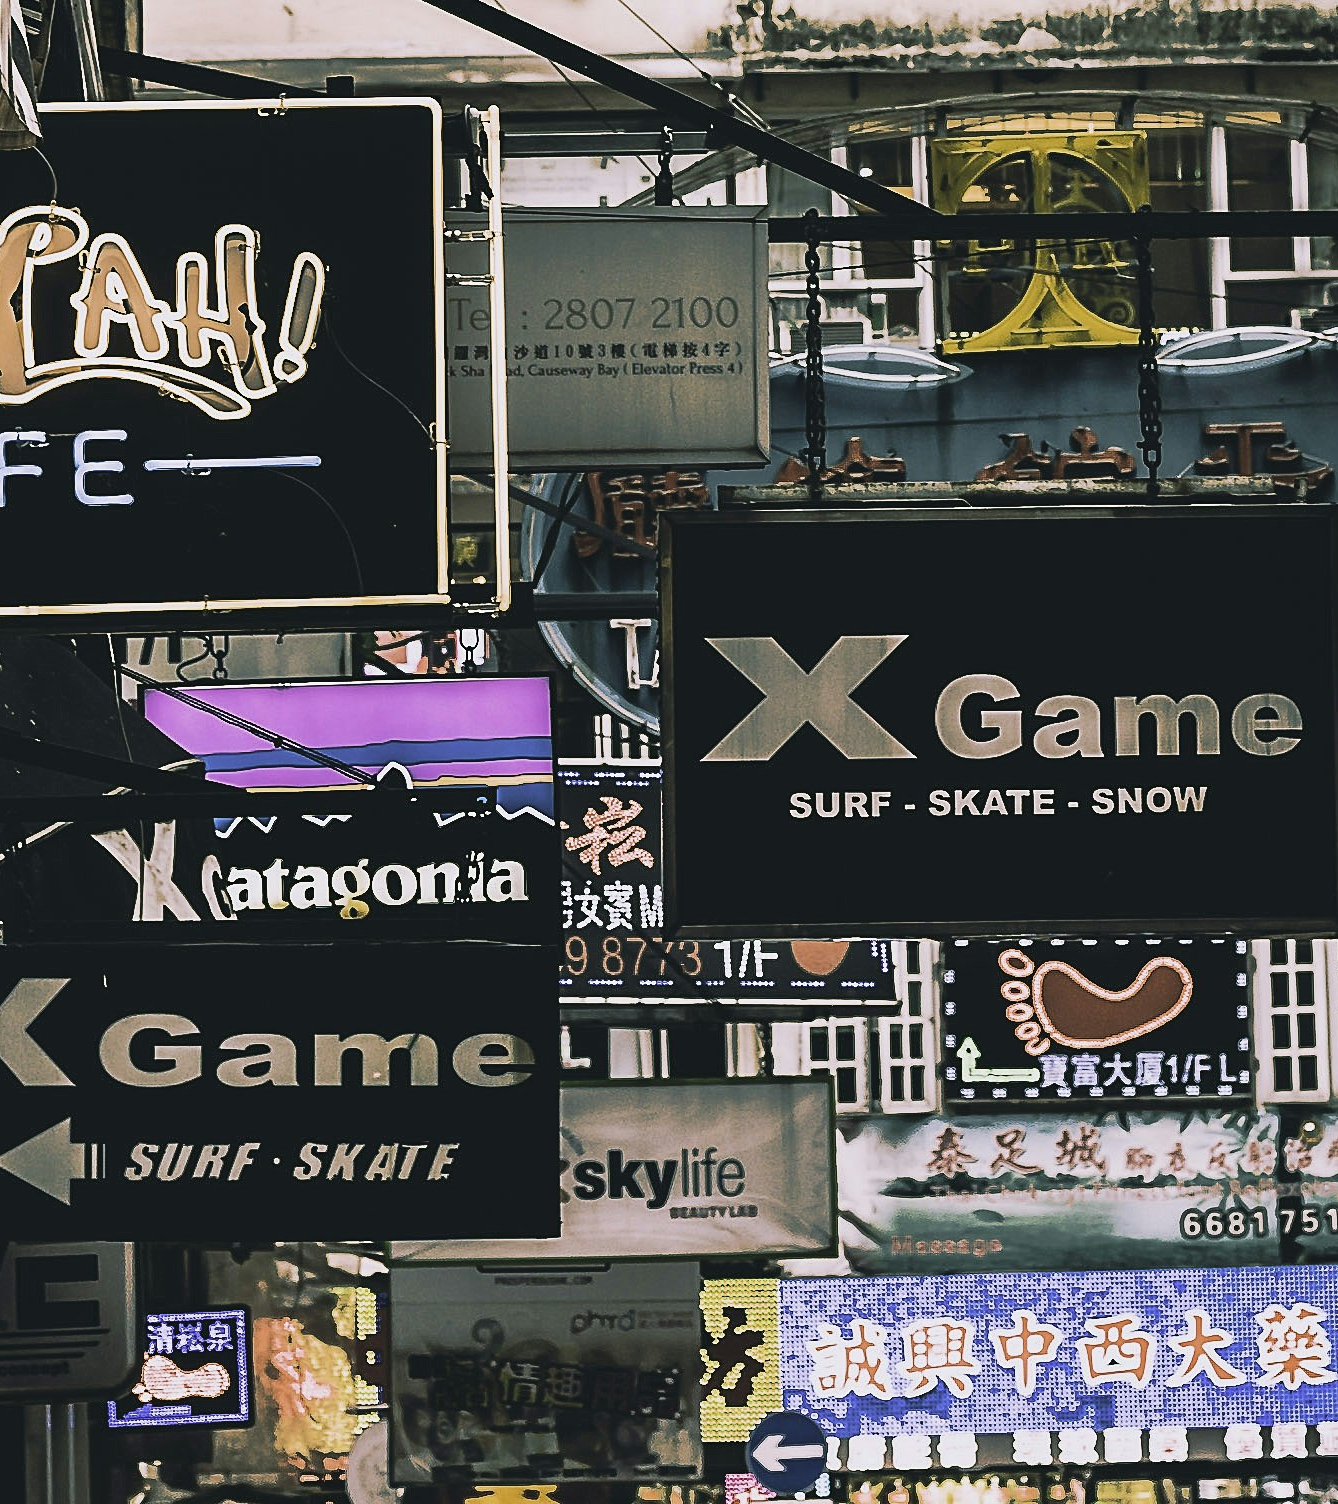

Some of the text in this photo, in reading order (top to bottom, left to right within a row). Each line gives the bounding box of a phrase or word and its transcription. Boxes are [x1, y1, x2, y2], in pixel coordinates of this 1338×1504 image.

[449, 297, 491, 332] Te
[544, 296, 636, 331] 2807
[651, 295, 740, 330] 2100
[461, 363, 486, 377] Sha
[528, 363, 594, 381] Causeway
[597, 362, 620, 380] Bay
[689, 359, 724, 377] Press
[699, 635, 1304, 762] X Game
[789, 791, 892, 819] SURF
[928, 789, 1057, 817] SKATE
[1091, 786, 1209, 815] SNOW
[227, 852, 530, 921] atagonia
[714, 939, 779, 979] 1/F
[98, 1013, 537, 1088] Game
[124, 1141, 462, 1183] SURF SKATE
[1183, 1210, 1266, 1238] 6681
